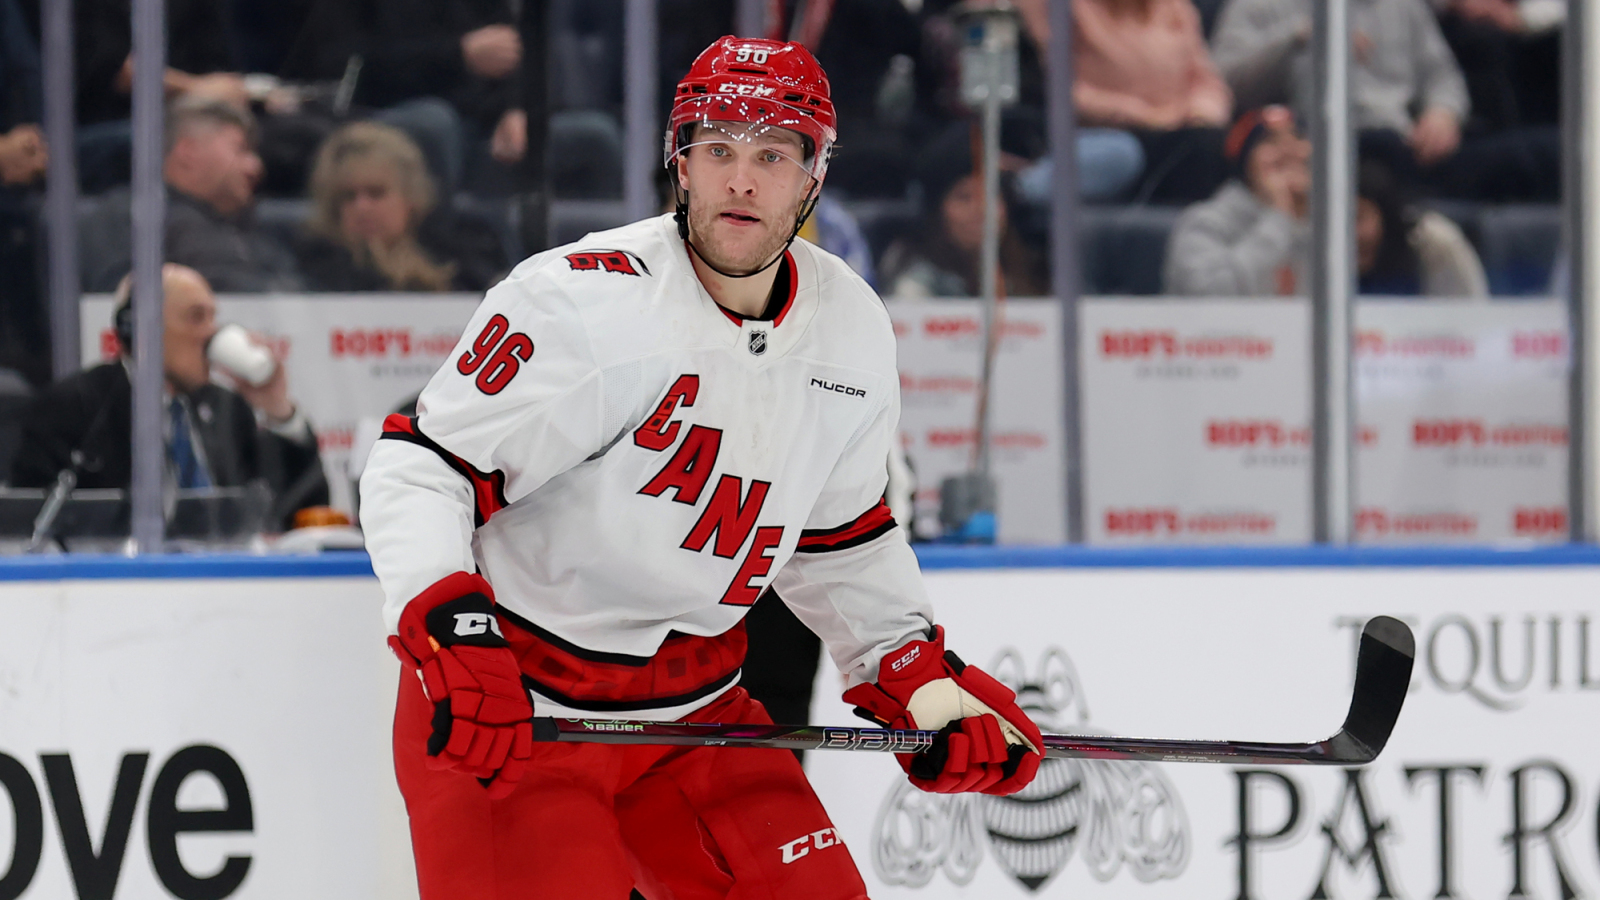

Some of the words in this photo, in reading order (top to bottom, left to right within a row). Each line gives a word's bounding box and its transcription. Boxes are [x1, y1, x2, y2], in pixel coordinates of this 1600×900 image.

[718, 83, 774, 97] CCM
[457, 313, 534, 396] 96
[810, 378, 867, 398] NUCOR
[891, 645, 920, 670] CCM
[1334, 613, 1600, 711] TQUIL
[595, 723, 644, 732] BAUER
[1225, 758, 1600, 900] PATR
